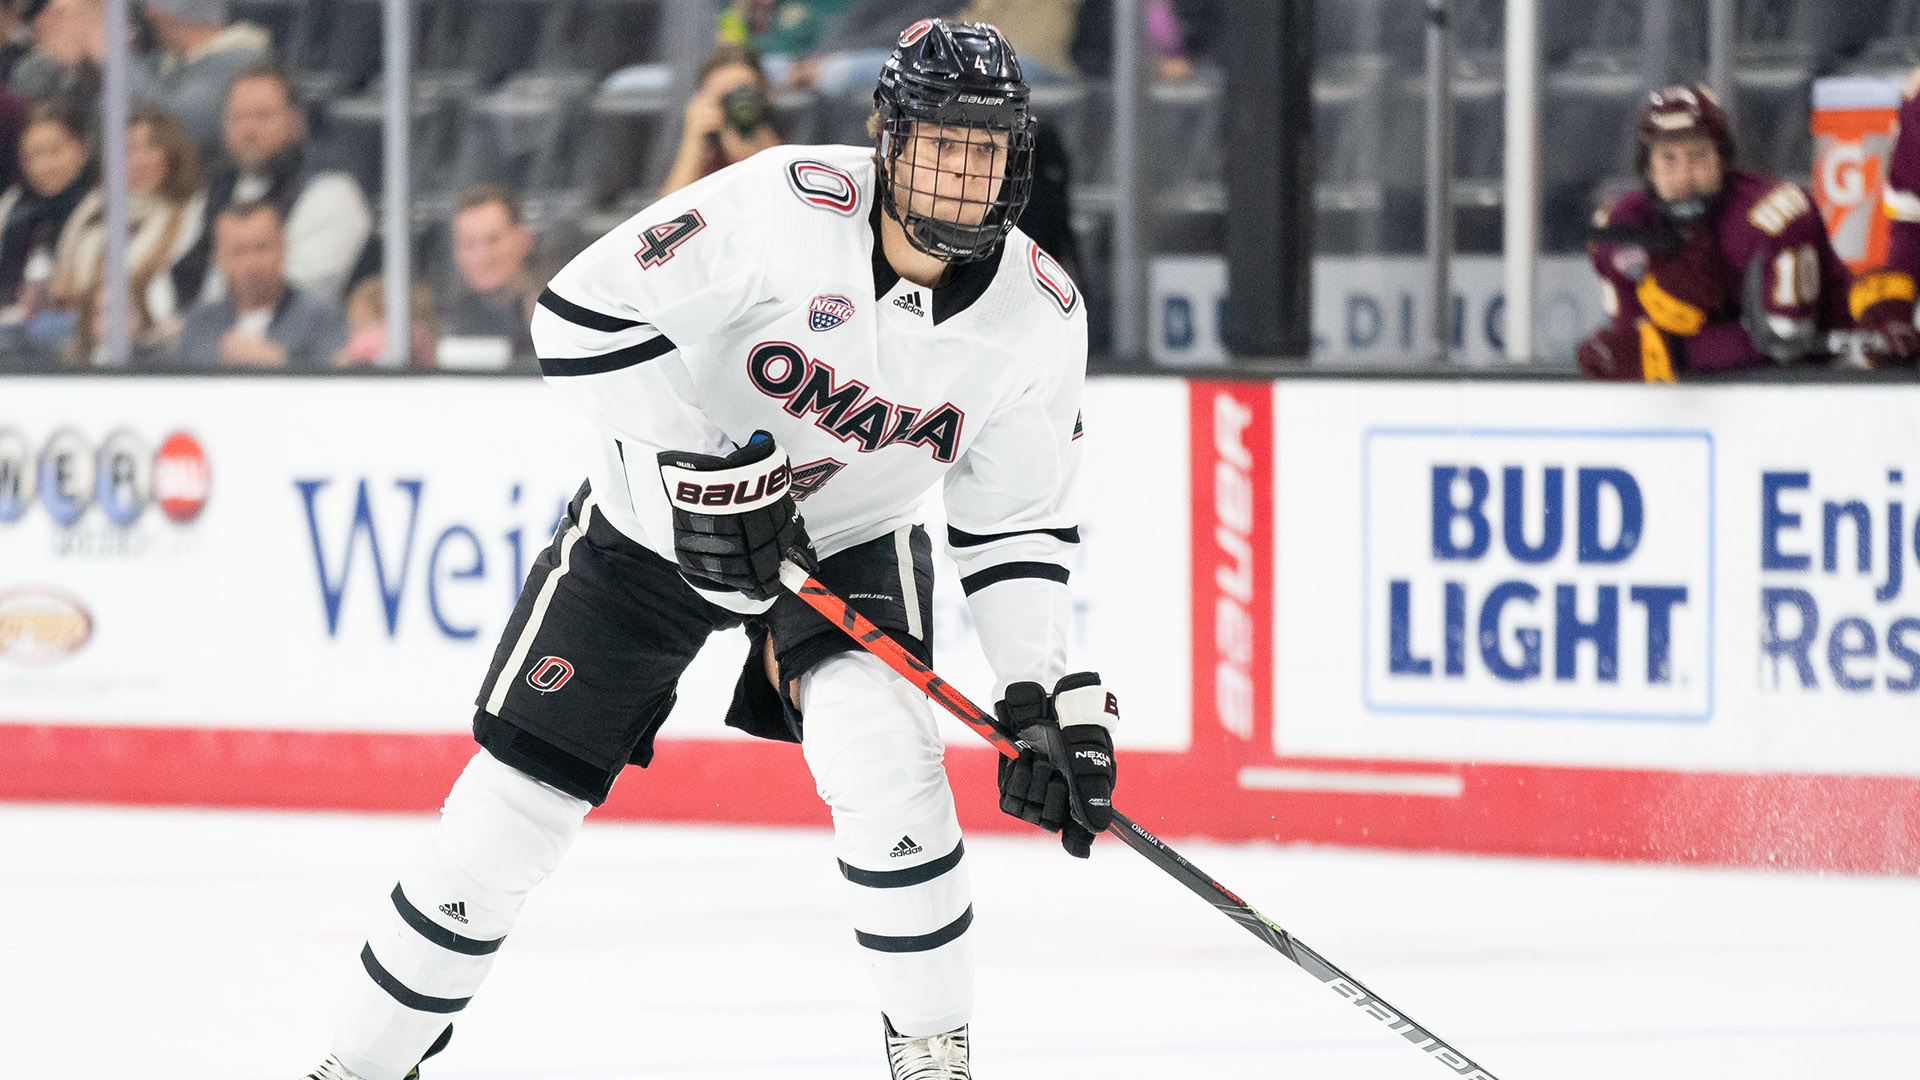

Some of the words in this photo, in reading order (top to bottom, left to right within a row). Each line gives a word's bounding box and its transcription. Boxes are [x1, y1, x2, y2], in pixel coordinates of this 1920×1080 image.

[974, 55, 987, 74] 4
[957, 94, 1004, 106] BAUER
[635, 208, 707, 271] 4
[1773, 246, 1821, 308] 10
[811, 298, 855, 320] NCHC
[893, 298, 925, 318] adidas
[1430, 464, 1645, 565] BUD
[1761, 468, 1920, 604] Enj
[292, 477, 570, 641] Wei
[1213, 391, 1254, 742] BAUER
[1387, 580, 1688, 685] LIGHT
[890, 845, 924, 858] adidas
[1131, 823, 1158, 846] OMAHA
[438, 904, 469, 925] adidas
